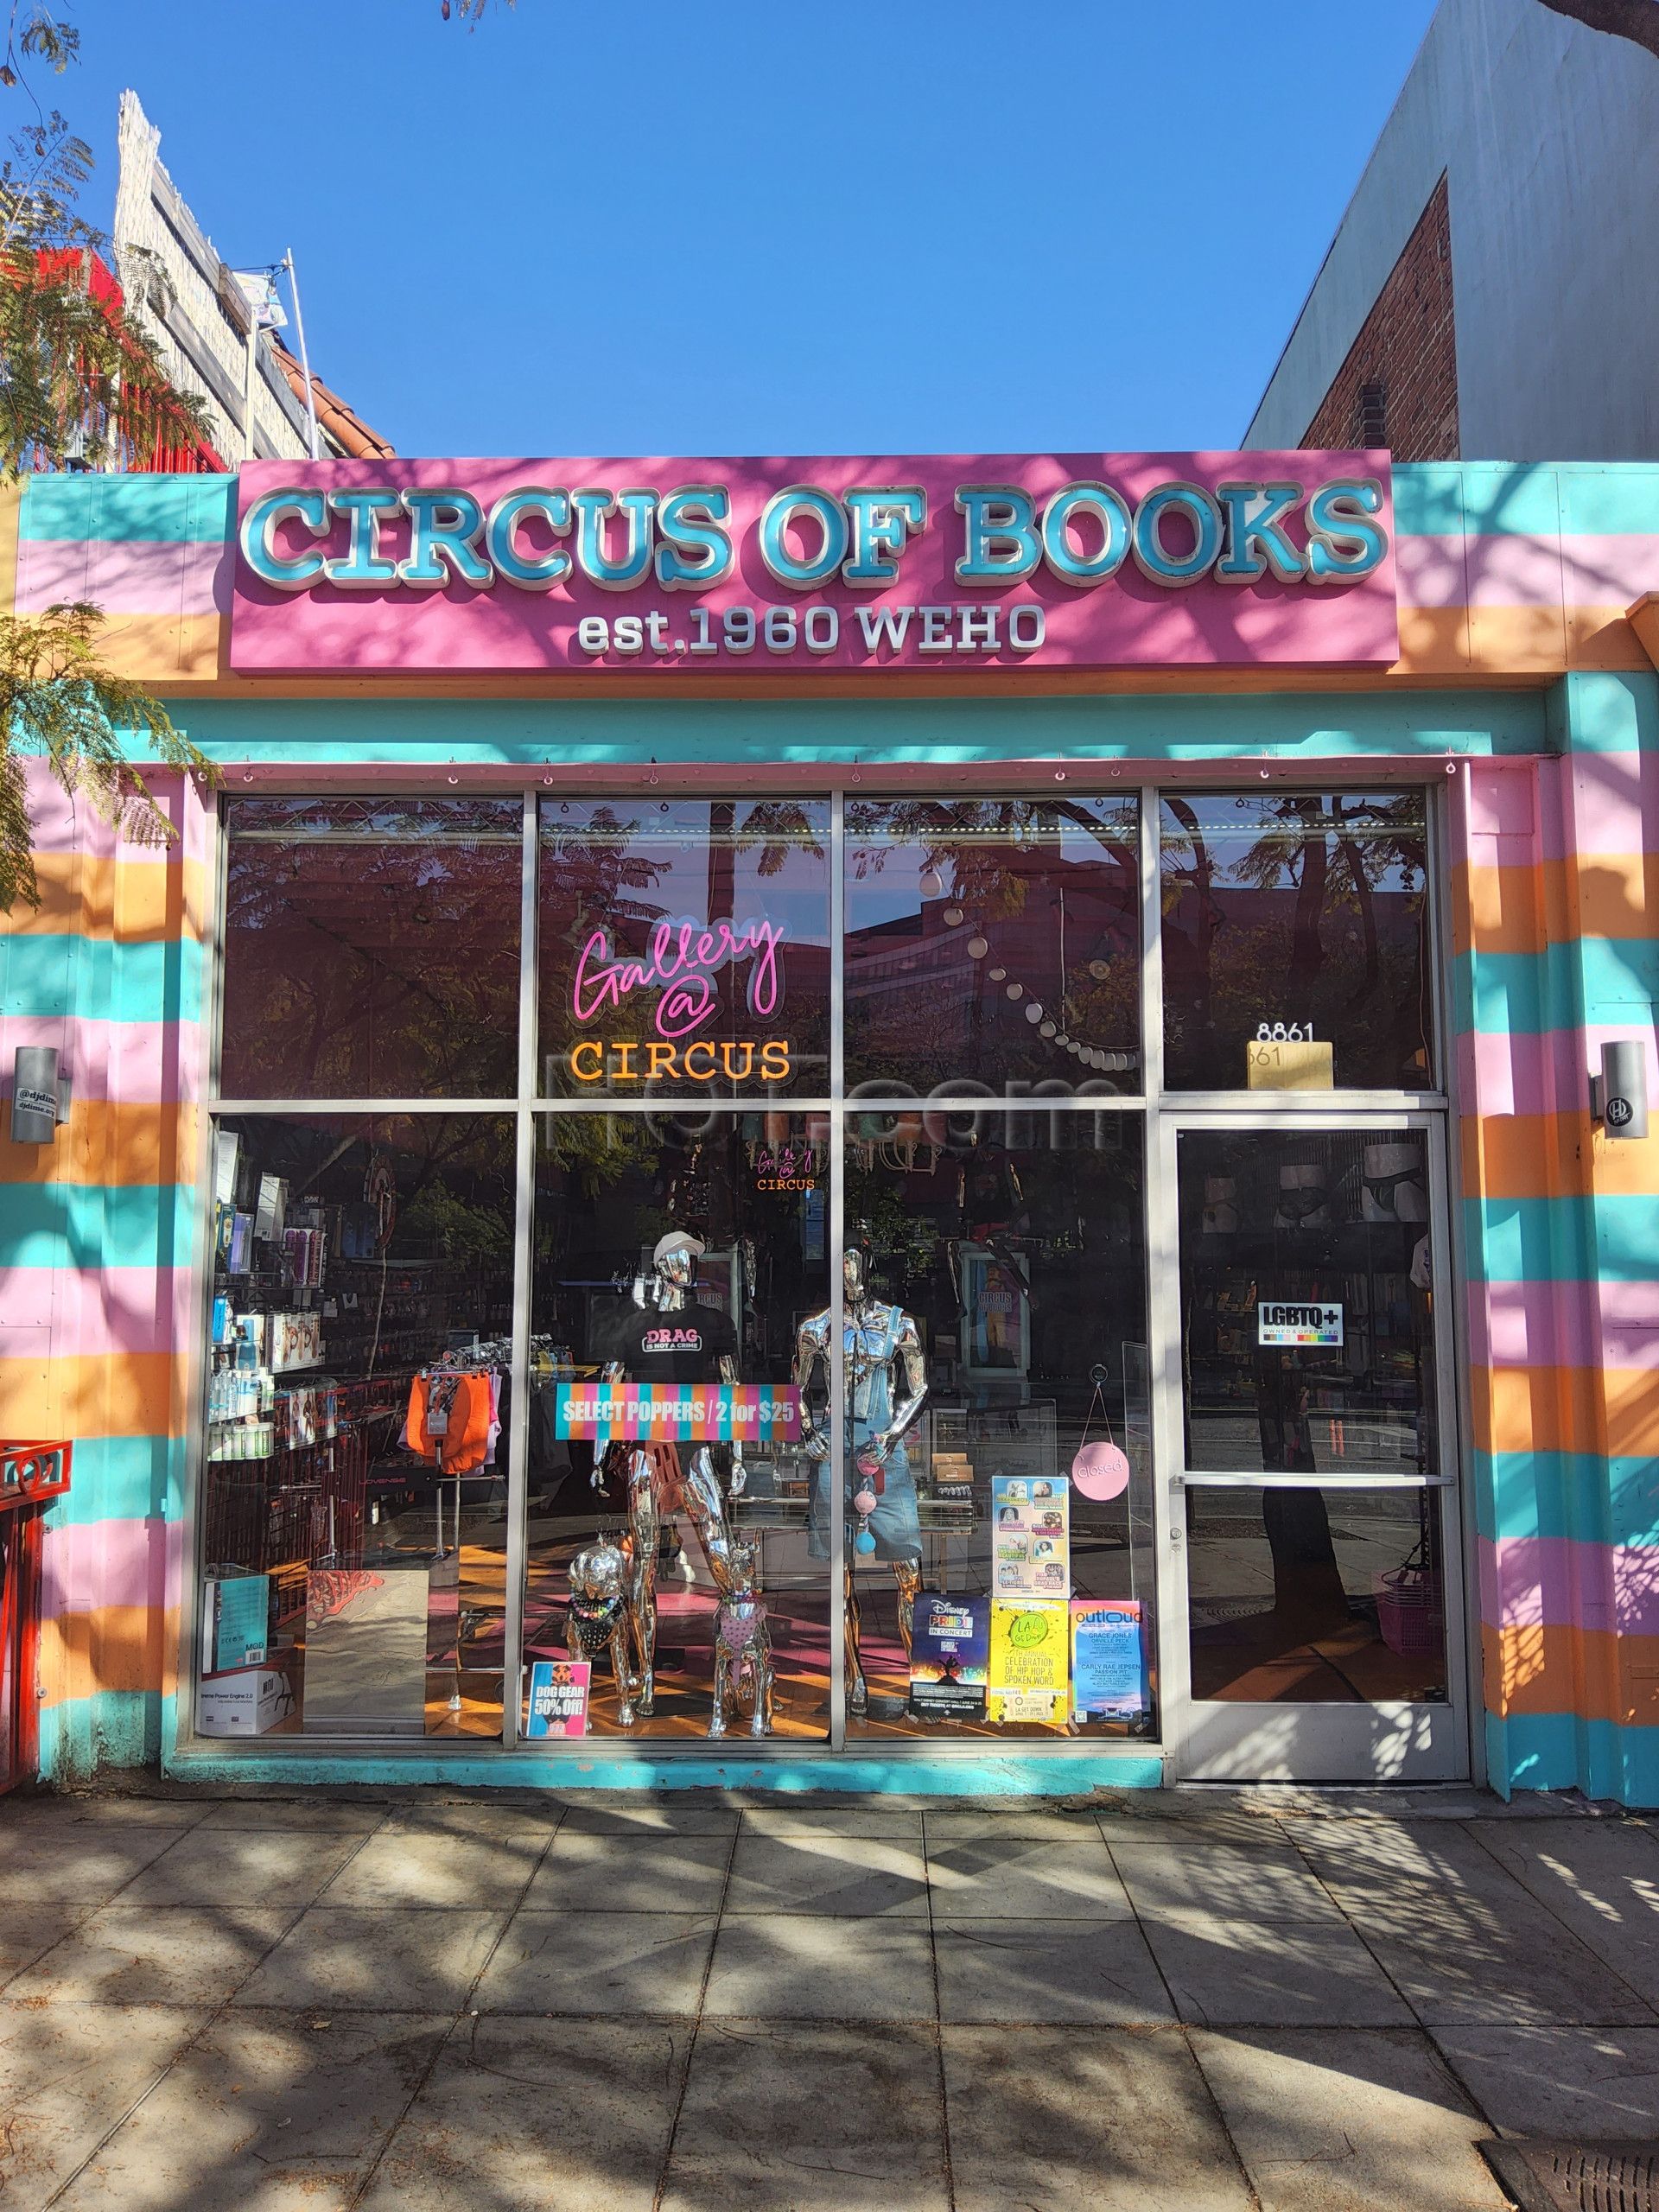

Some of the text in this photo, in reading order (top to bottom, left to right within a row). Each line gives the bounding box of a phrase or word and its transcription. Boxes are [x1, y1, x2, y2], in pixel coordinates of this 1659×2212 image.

[240, 479, 1389, 592] CIRCUS OF BOOKS
[578, 605, 1046, 656] est.1960 WEHO
[575, 920, 785, 1020] Gallery
[656, 975, 715, 1037] @
[1256, 1022, 1313, 1042] 8861
[571, 1040, 791, 1080] CIRCUS
[757, 1179, 815, 1190] CIRCUS
[1263, 1306, 1338, 1329] LGBTQ+
[646, 1328, 698, 1344] DRAG
[563, 1401, 625, 1422] SELECT
[627, 1401, 705, 1422] POPPERS
[715, 1401, 728, 1422] 2
[730, 1401, 757, 1422] for
[759, 1400, 794, 1424] $25
[931, 1599, 969, 1618] Disney
[1076, 1609, 1142, 1623] outloud
[1005, 1656, 1053, 1667] CELEBRATION
[1005, 1666, 1053, 1676] OF HIP HOP &
[1004, 1675, 1054, 1686] SPOKEN WORD
[536, 1686, 585, 1698] DOG GEAR
[534, 1698, 584, 1715] 50% Off!
